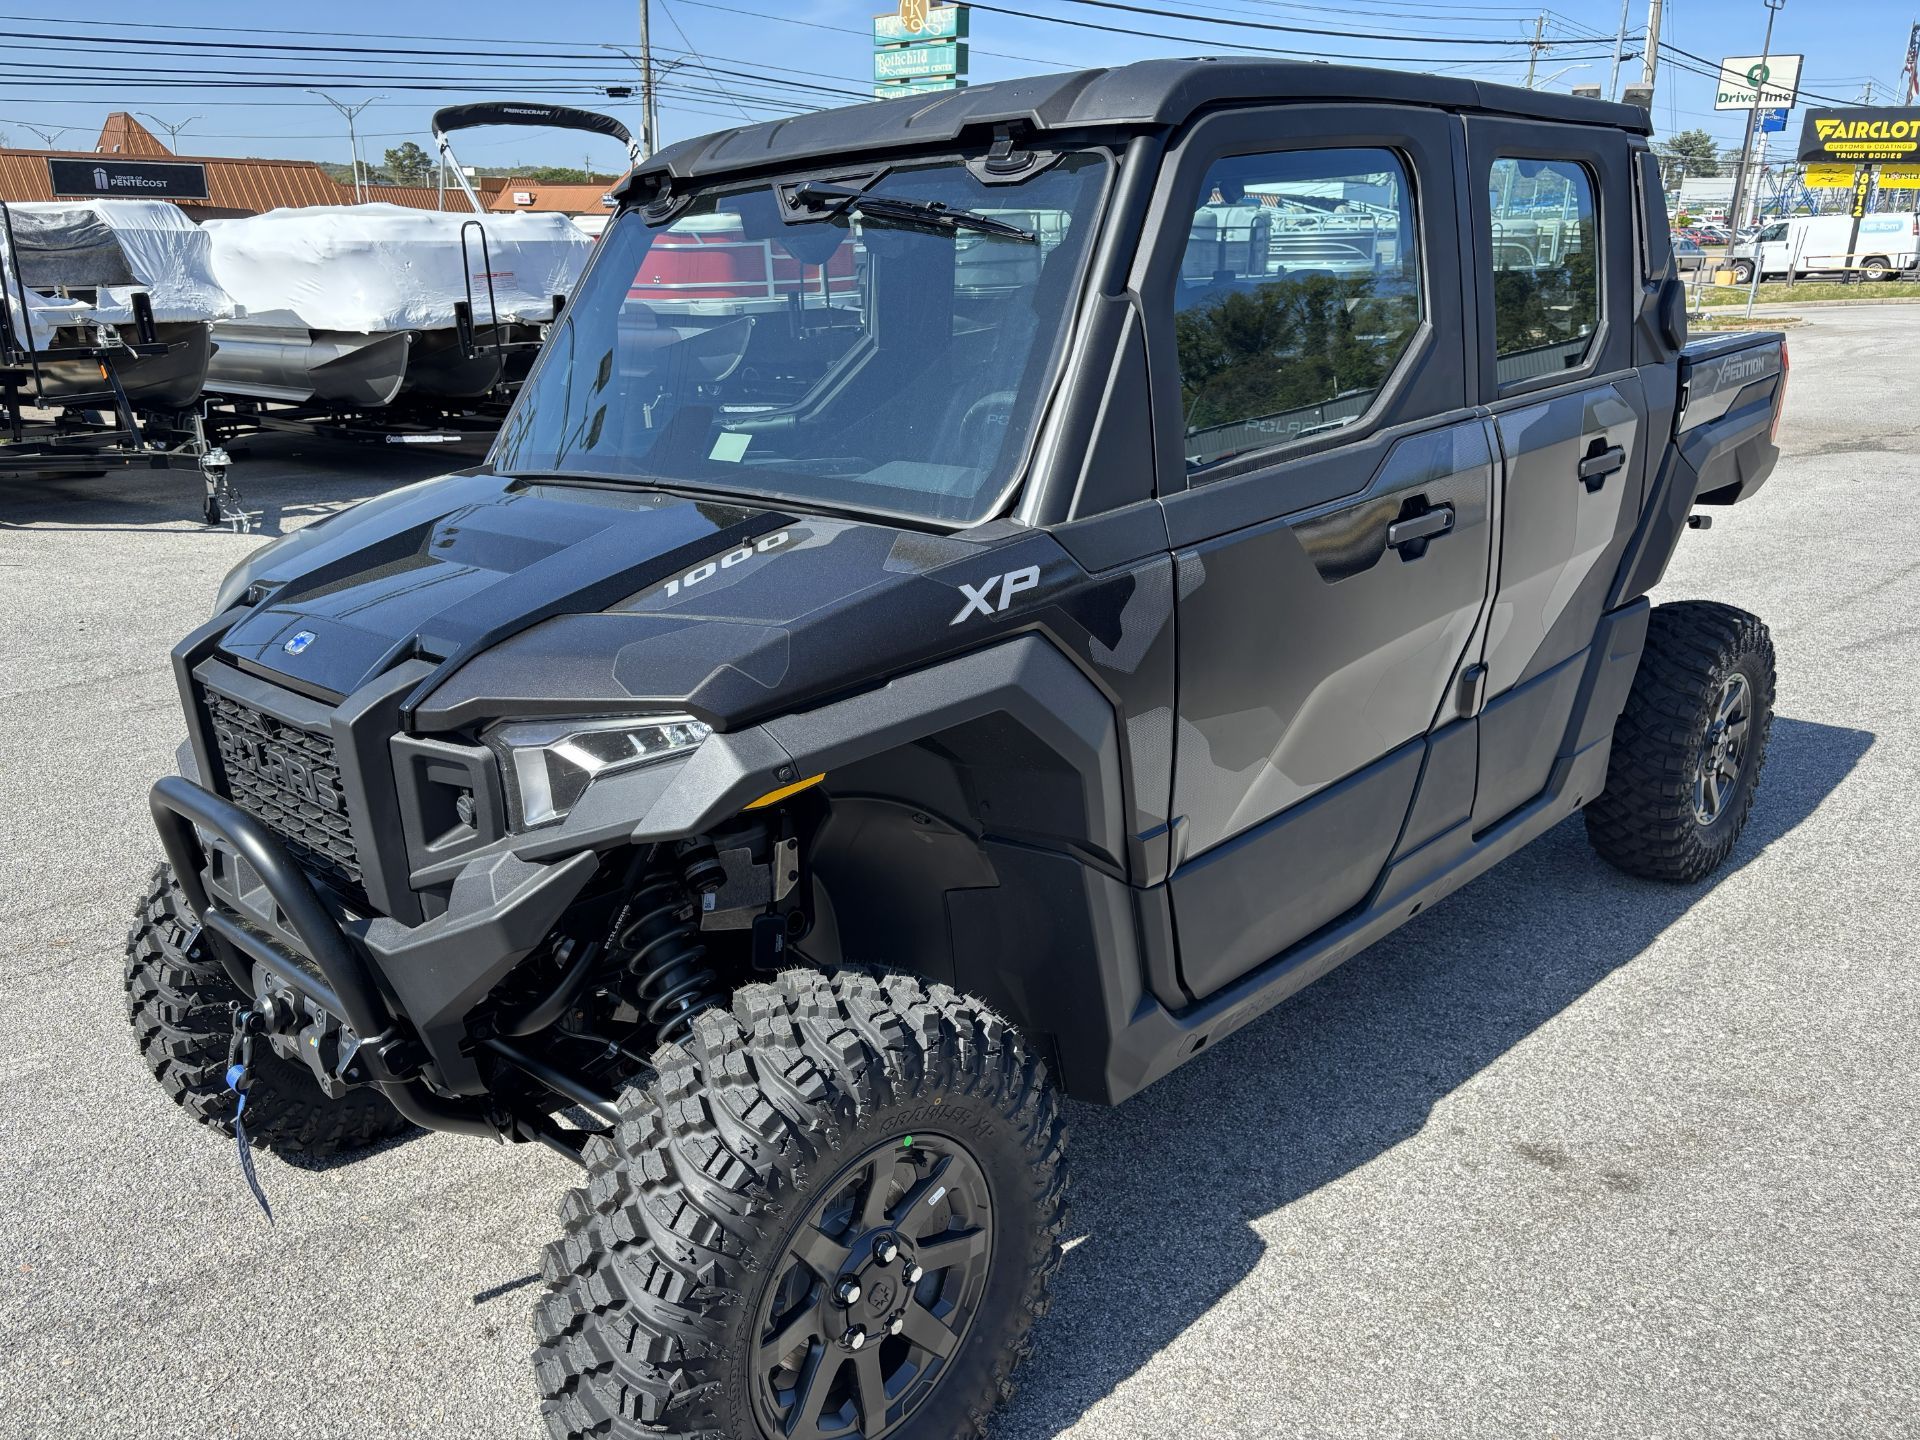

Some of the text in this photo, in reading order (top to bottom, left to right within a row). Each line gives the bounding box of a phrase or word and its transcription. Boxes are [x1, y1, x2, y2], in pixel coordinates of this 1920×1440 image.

[503, 107, 551, 116] PRINCECRAFT
[110, 179, 168, 188] PENTECOST
[1713, 355, 1765, 393] XPEDITION
[664, 531, 789, 598] 1000
[949, 565, 1040, 626] XP
